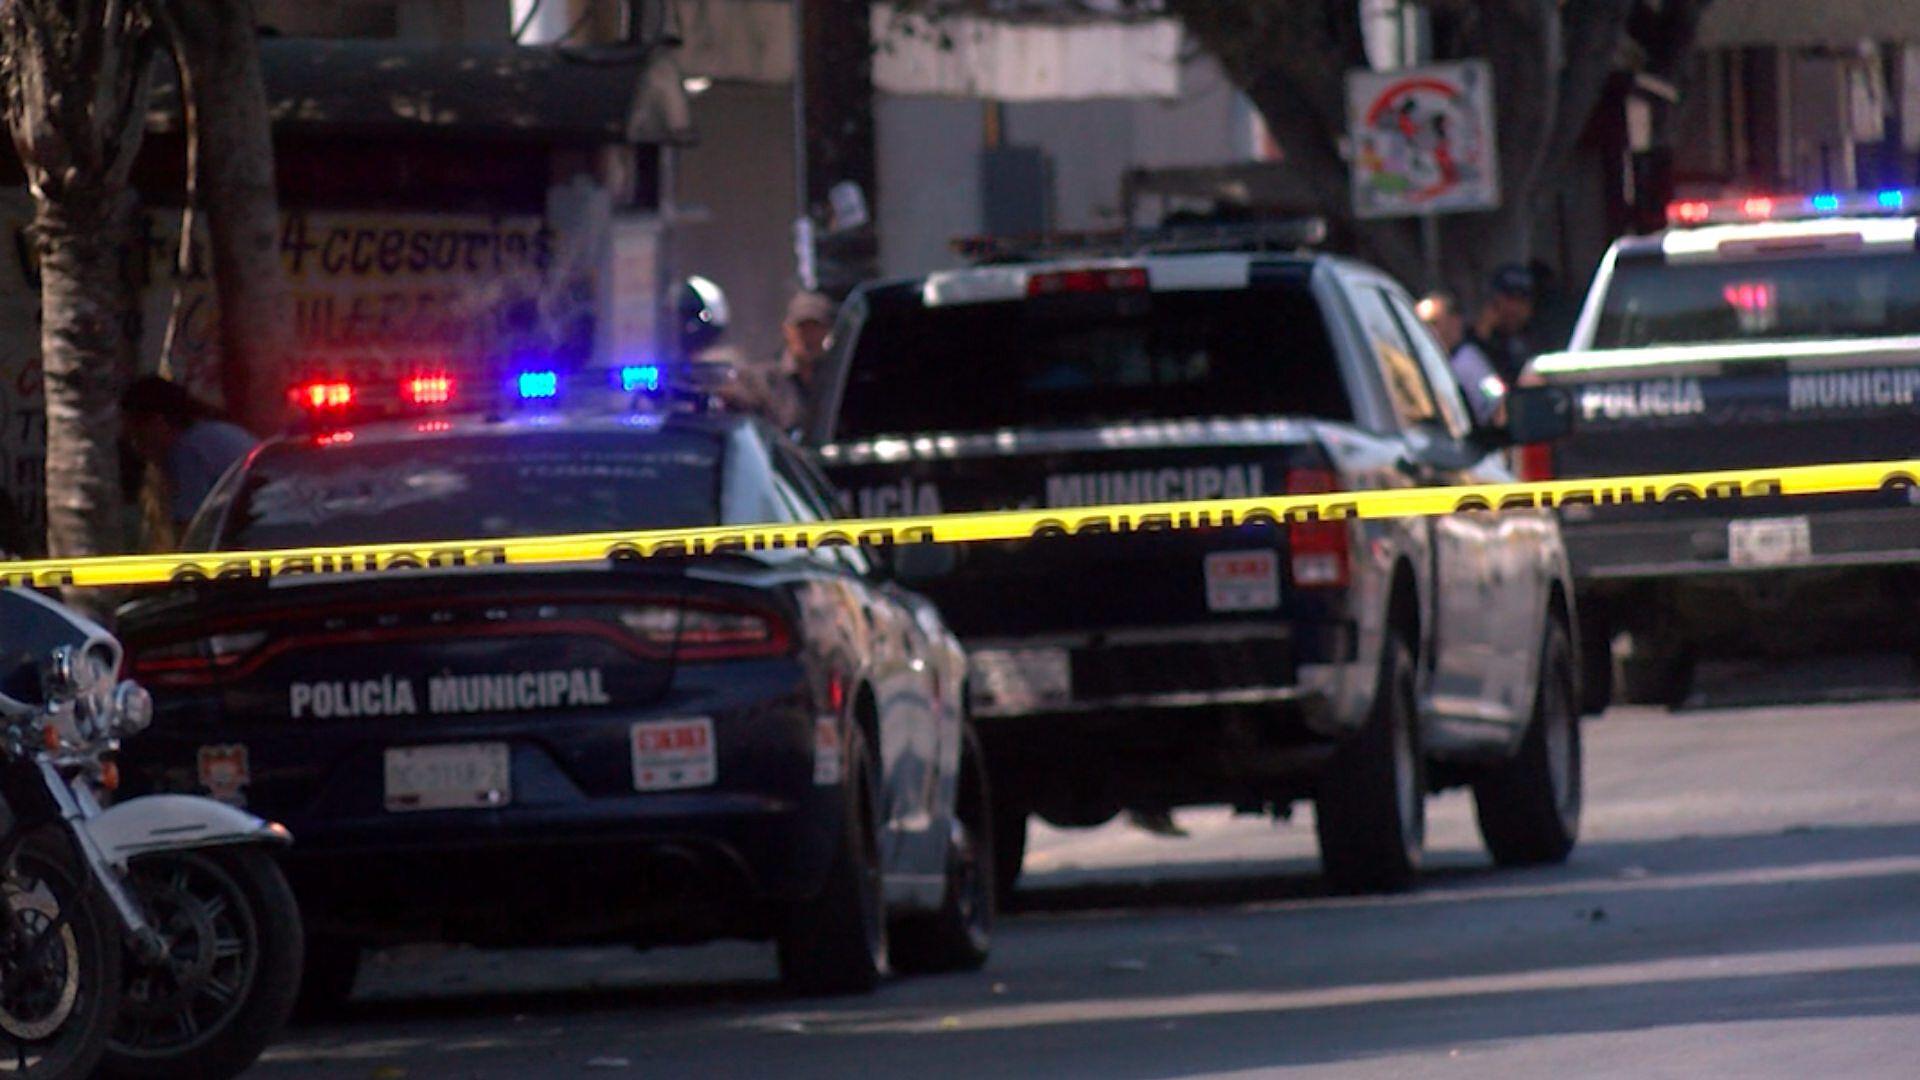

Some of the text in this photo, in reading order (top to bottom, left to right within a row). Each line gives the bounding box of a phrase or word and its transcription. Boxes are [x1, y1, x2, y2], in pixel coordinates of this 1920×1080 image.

[1582, 377, 1706, 418] POLICÍA
[290, 668, 608, 718] POLICÍA MUNICIPAL
